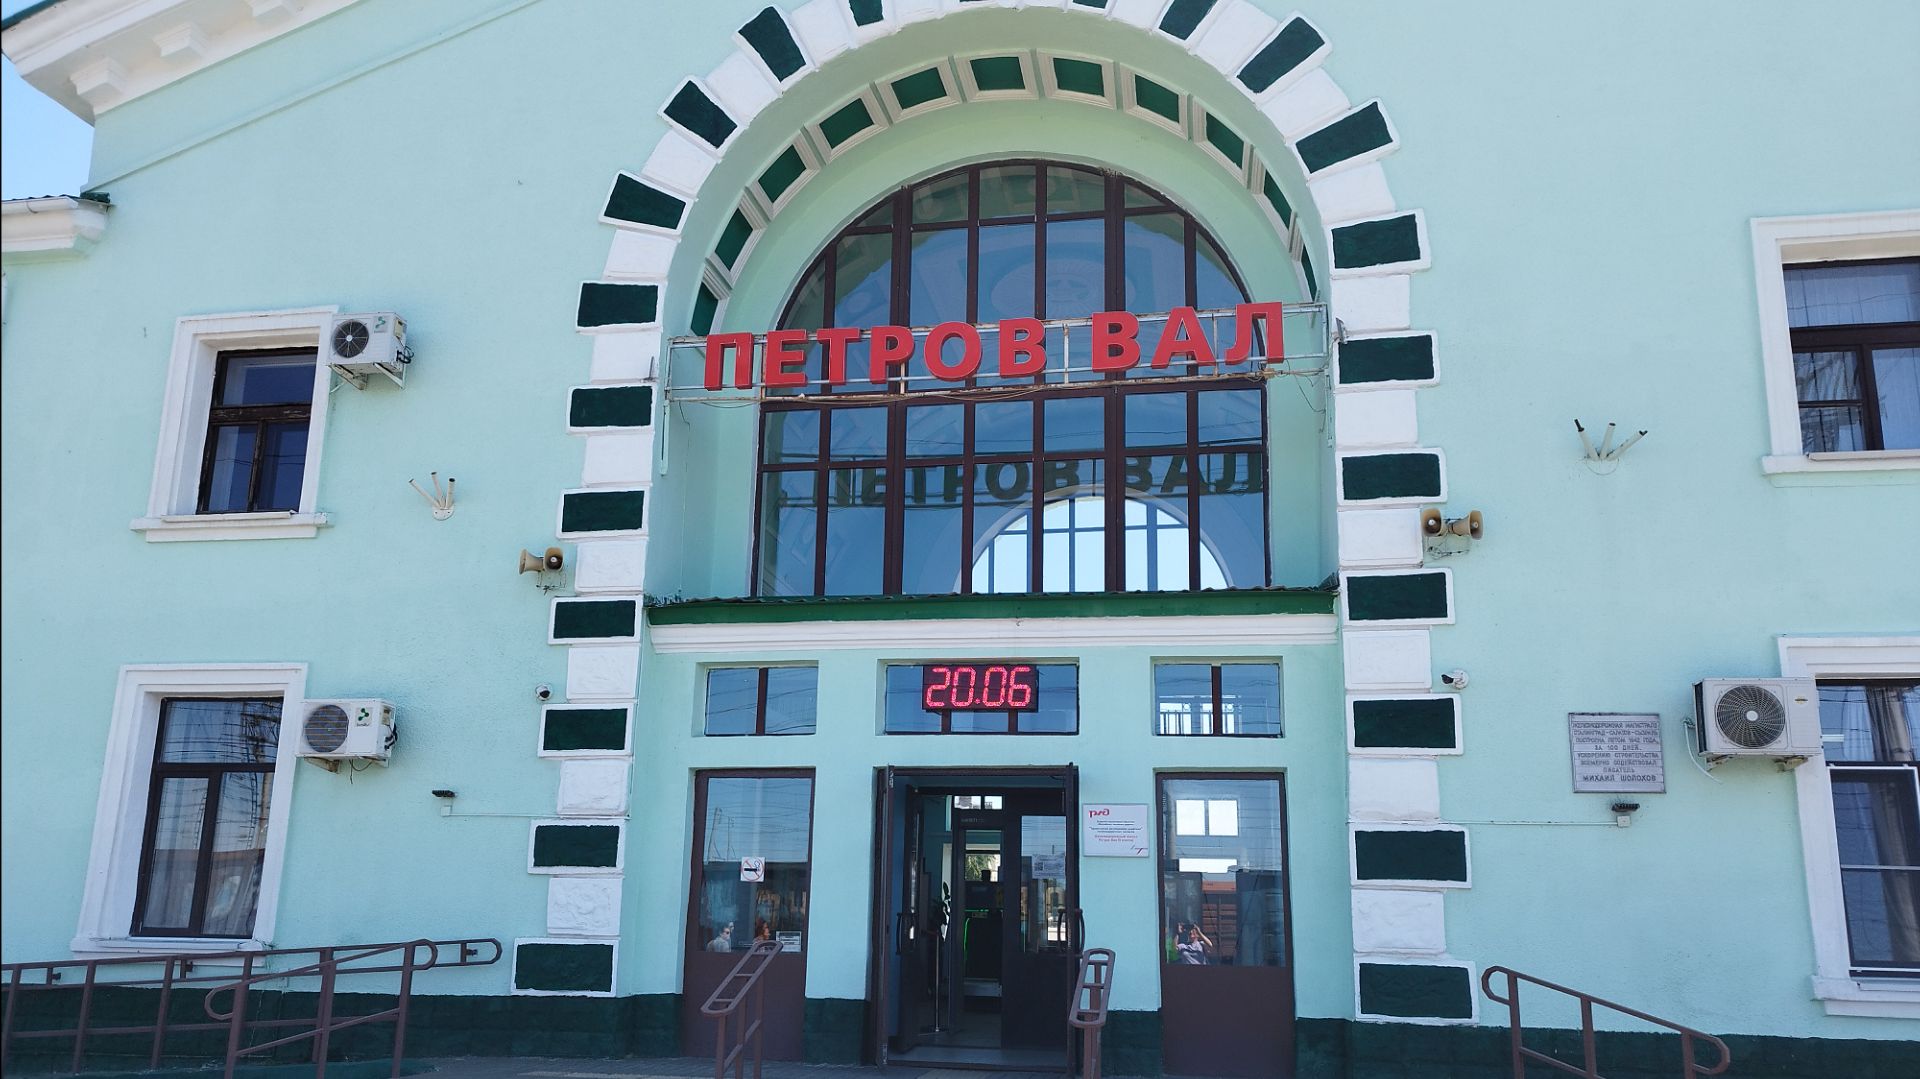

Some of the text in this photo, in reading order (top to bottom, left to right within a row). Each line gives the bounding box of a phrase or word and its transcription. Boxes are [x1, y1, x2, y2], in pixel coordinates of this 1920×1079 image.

[704, 302, 1284, 391] ПЕТРОВ ВАЛ
[926, 666, 1031, 706] 20.06
